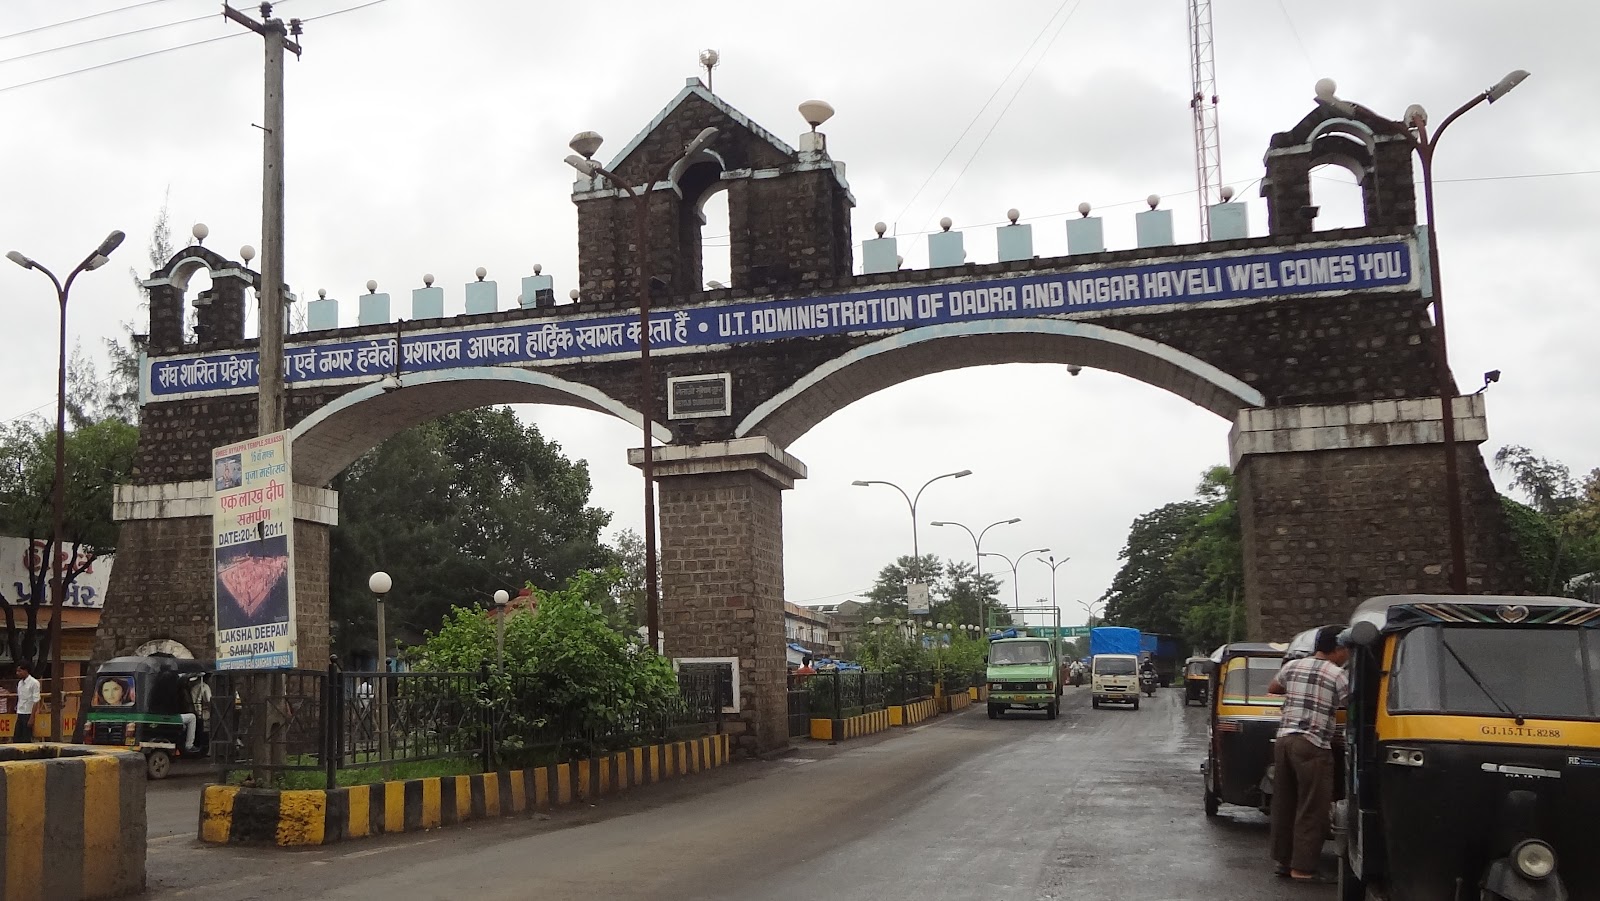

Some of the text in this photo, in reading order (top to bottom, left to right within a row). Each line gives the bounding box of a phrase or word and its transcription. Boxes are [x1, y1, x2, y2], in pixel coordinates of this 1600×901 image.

[718, 312, 749, 337] U.T.
[752, 295, 913, 334] ADMINISTRATION
[917, 292, 944, 319] OF
[949, 286, 1017, 316] DADRA
[1021, 280, 1064, 309] AND
[1067, 273, 1140, 306] NAGAR
[1143, 267, 1223, 300] HAVELI
[1357, 250, 1407, 281] YOU.
[159, 364, 179, 388] संघ
[181, 359, 219, 387] शासित
[220, 355, 254, 385] प्रदेश
[293, 348, 317, 379] एवं
[319, 348, 354, 373] नगर
[357, 341, 398, 373] हवेली
[402, 338, 462, 365] प्रशासन
[467, 332, 522, 358] आपका
[576, 323, 626, 350] स्वागत
[673, 310, 691, 344] हैं
[245, 462, 286, 485] पूजा महोत्सव
[220, 478, 285, 513] एक लाख दीप
[237, 505, 271, 526] समर्पण
[220, 623, 289, 644] LAKSHA DEEPAM
[229, 640, 275, 657] SAMARPAN
